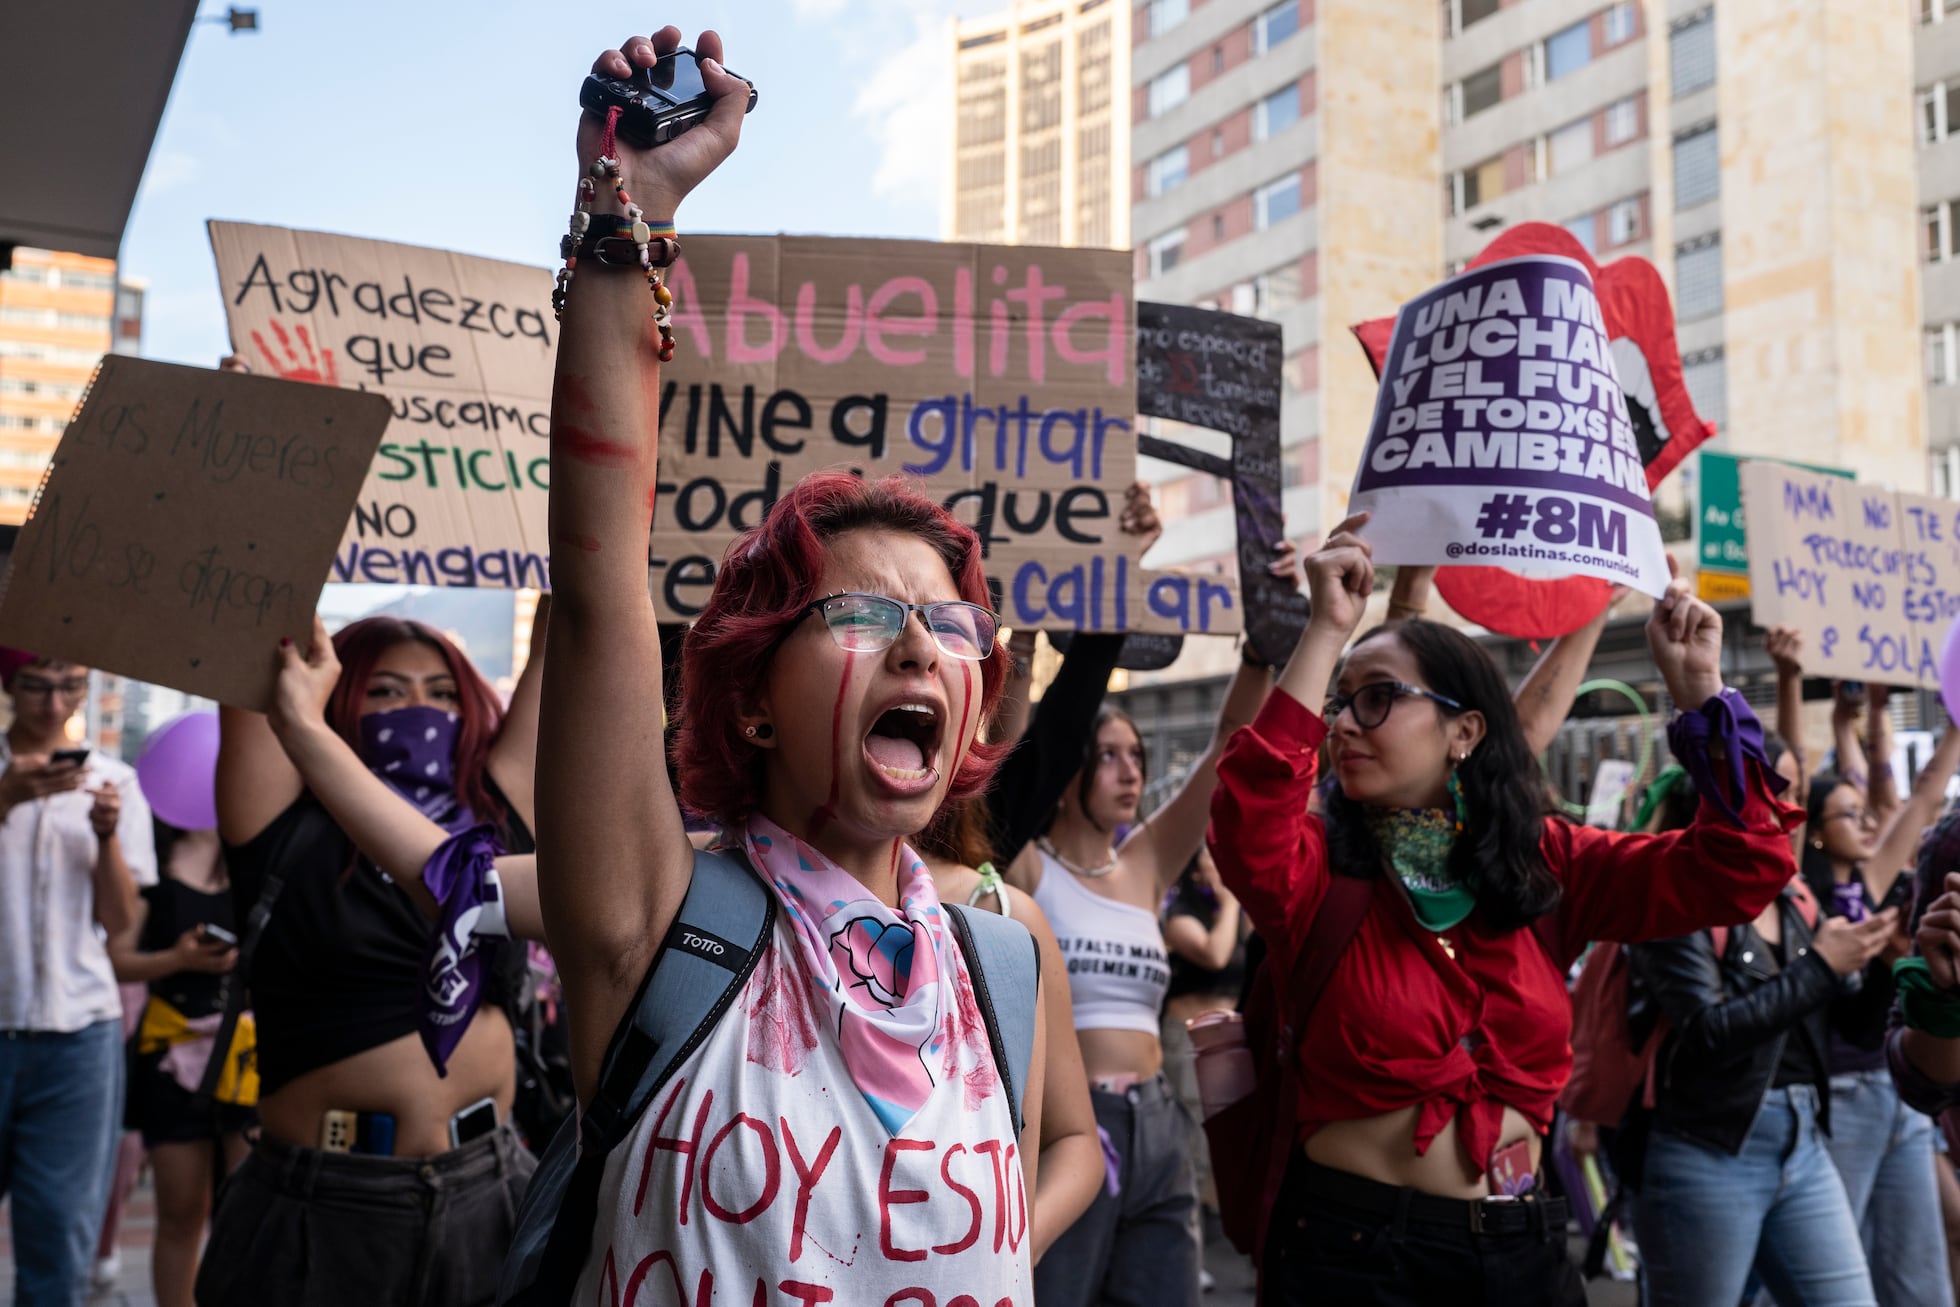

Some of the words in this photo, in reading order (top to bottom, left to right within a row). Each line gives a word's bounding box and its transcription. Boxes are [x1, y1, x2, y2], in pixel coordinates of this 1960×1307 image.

[235, 253, 551, 347] Agradezca
[667, 252, 1125, 387] Abuelita
[1413, 278, 1527, 338] UNA
[346, 335, 455, 385] que
[1392, 371, 1423, 409] Y
[1429, 360, 1504, 399] EL
[362, 384, 550, 438] uscamo
[1386, 401, 1444, 436] DE
[1454, 397, 1608, 443] TODXS
[172, 397, 340, 490] Mujeres
[355, 501, 416, 539] NO
[943, 481, 1110, 560] que
[1475, 493, 1628, 557] #8M
[1861, 498, 1891, 529] NO
[1906, 507, 1944, 542] TE
[333, 541, 550, 589] vengan
[1445, 541, 1640, 579] @doslatinas.comunidad
[1773, 556, 1827, 608] HOY
[1852, 580, 1886, 610] NO
[1858, 623, 1940, 680] SOLA
[682, 932, 725, 955] TOTTO
[1068, 958, 1138, 978] QUEMEN
[1075, 938, 1124, 957] FALTO
[634, 1078, 841, 1263] HOY
[878, 1138, 1026, 1262] ESTO
